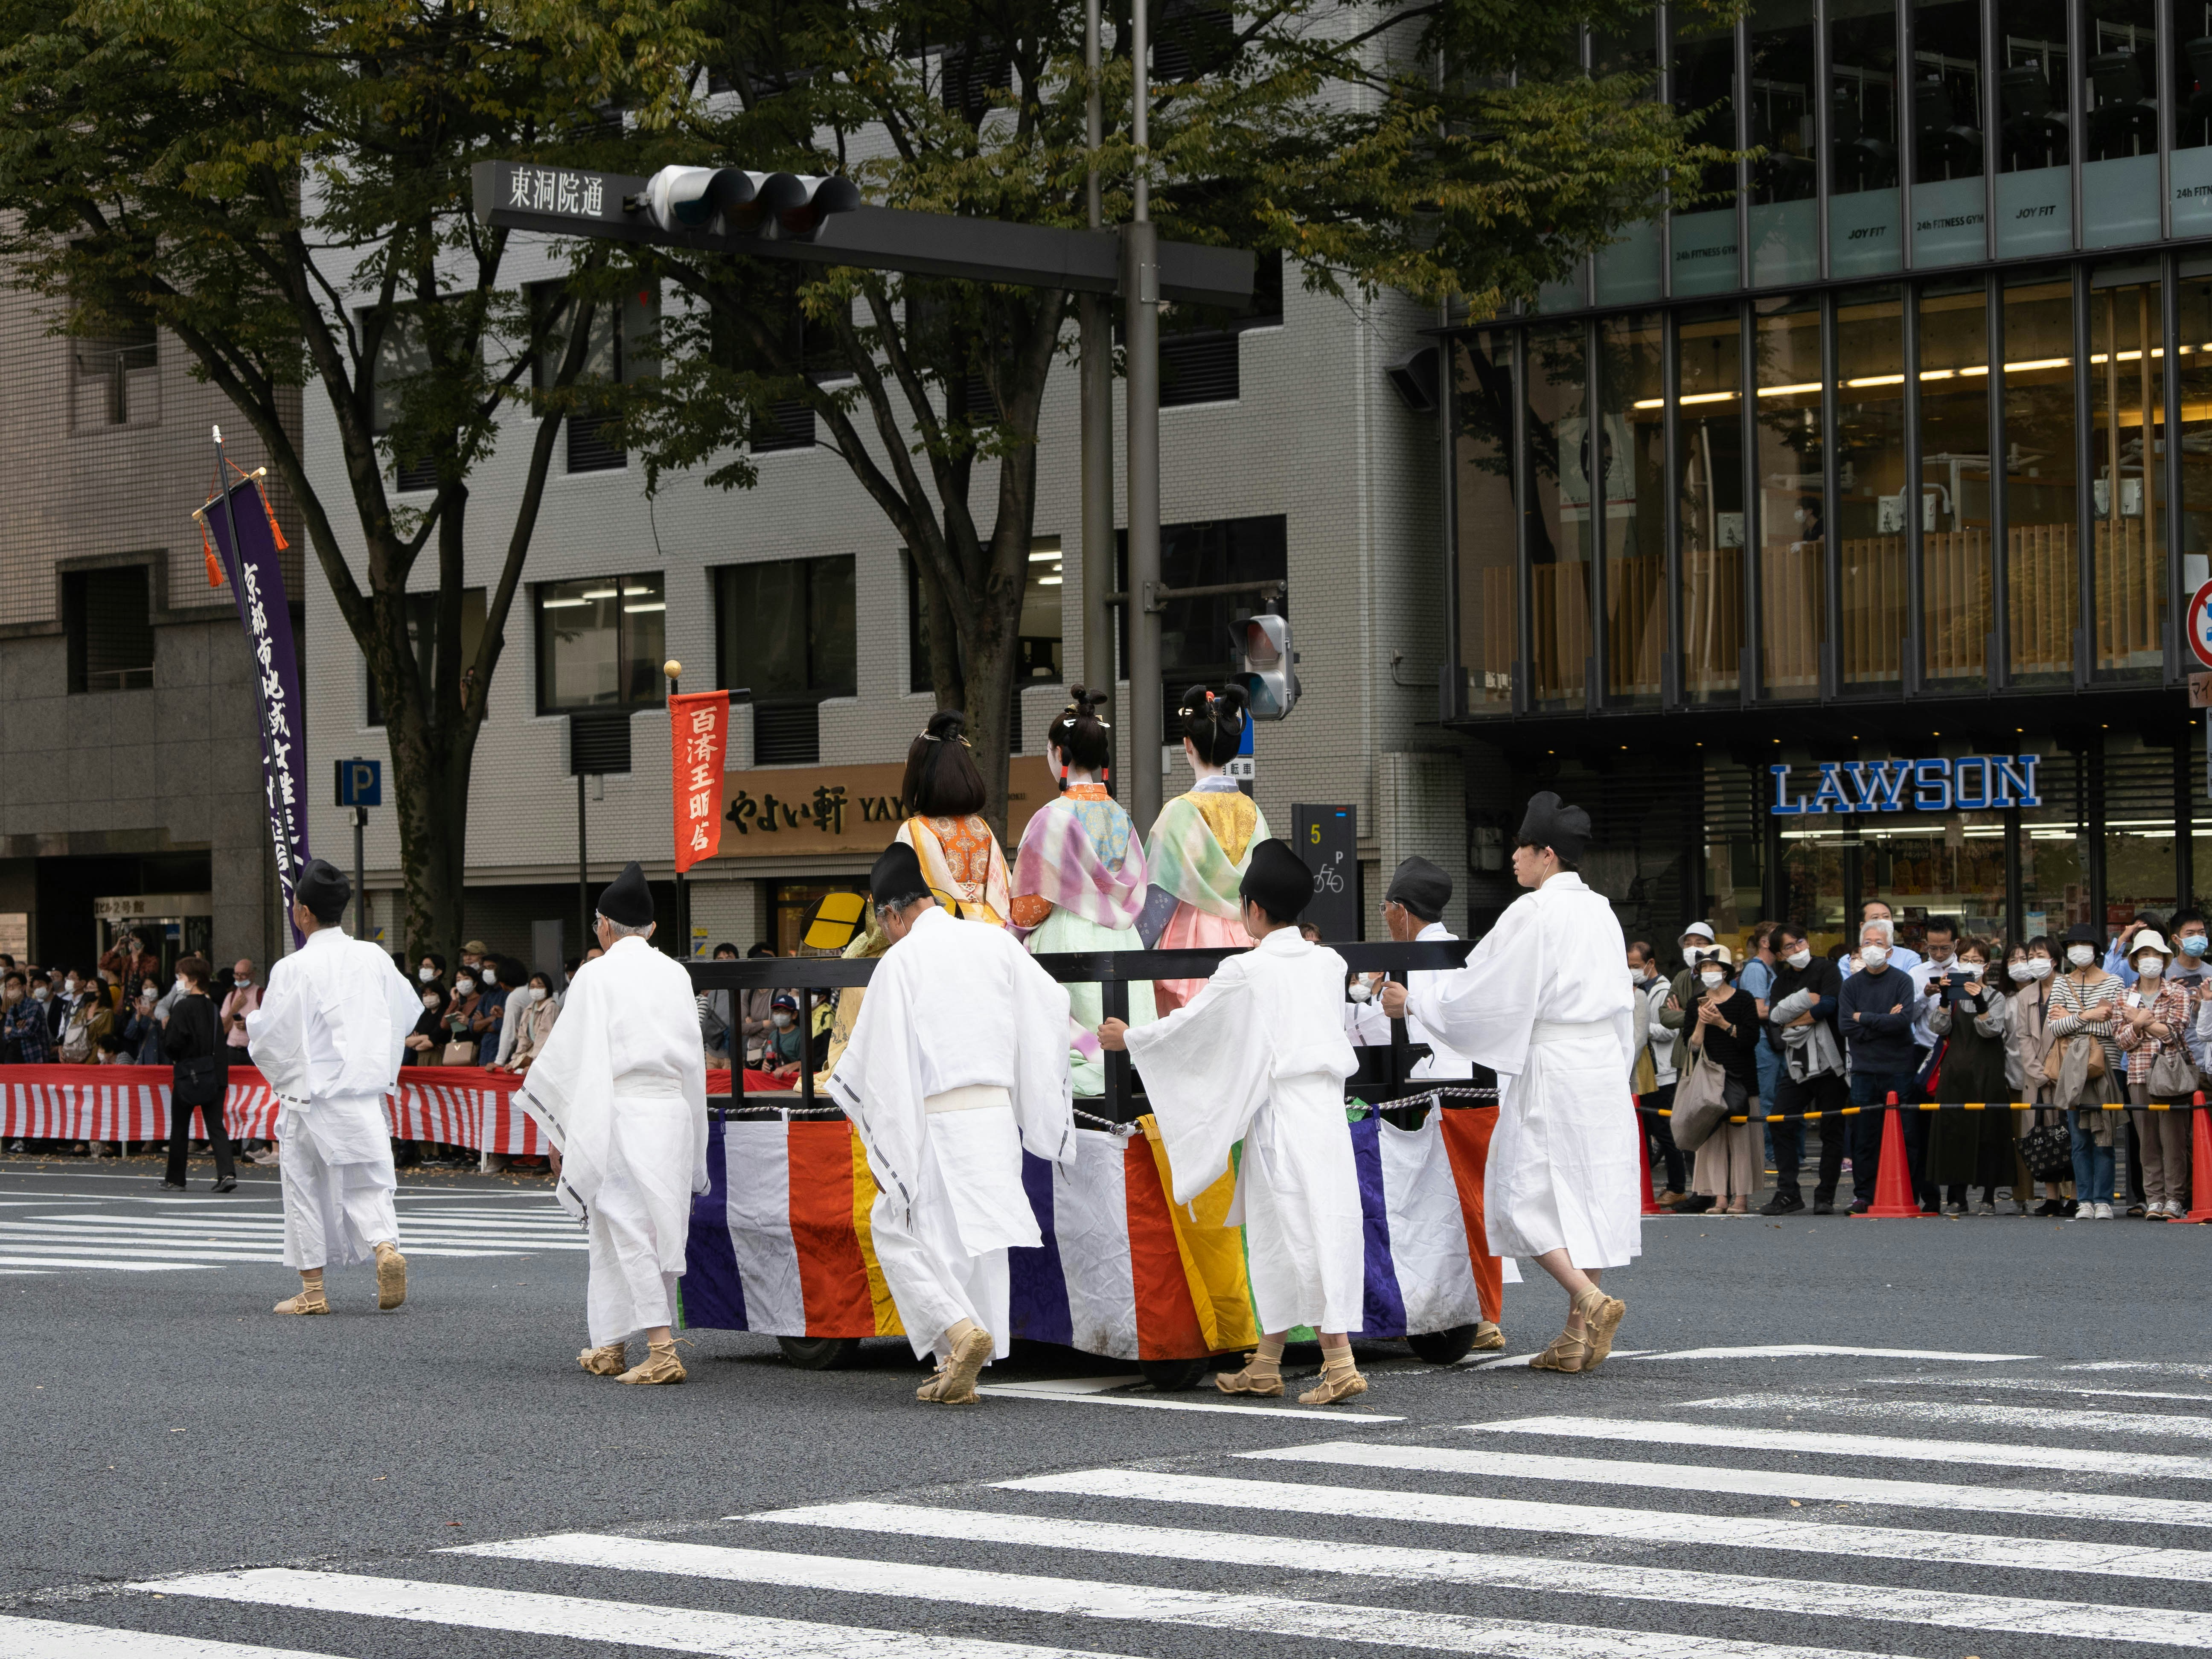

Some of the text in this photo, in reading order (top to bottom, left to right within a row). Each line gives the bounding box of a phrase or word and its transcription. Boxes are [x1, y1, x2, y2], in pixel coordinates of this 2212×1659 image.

[509, 166, 603, 216] 東洞院通
[2177, 189, 2192, 198] 24h
[2016, 205, 2056, 218] JOY FIT
[1917, 214, 1984, 231] 24h FITNESS GYM
[1848, 227, 1886, 239] JOY FIT
[1676, 245, 1738, 260] 24h FITNESS GYM
[2192, 680, 2212, 699] マイ
[352, 765, 373, 801] P
[687, 706, 719, 852] 百済王明信
[1770, 754, 2042, 815] LAWSON
[725, 785, 914, 835] やよい軒 YAY
[1311, 824, 1321, 844] 5
[1336, 851, 1343, 864] P
